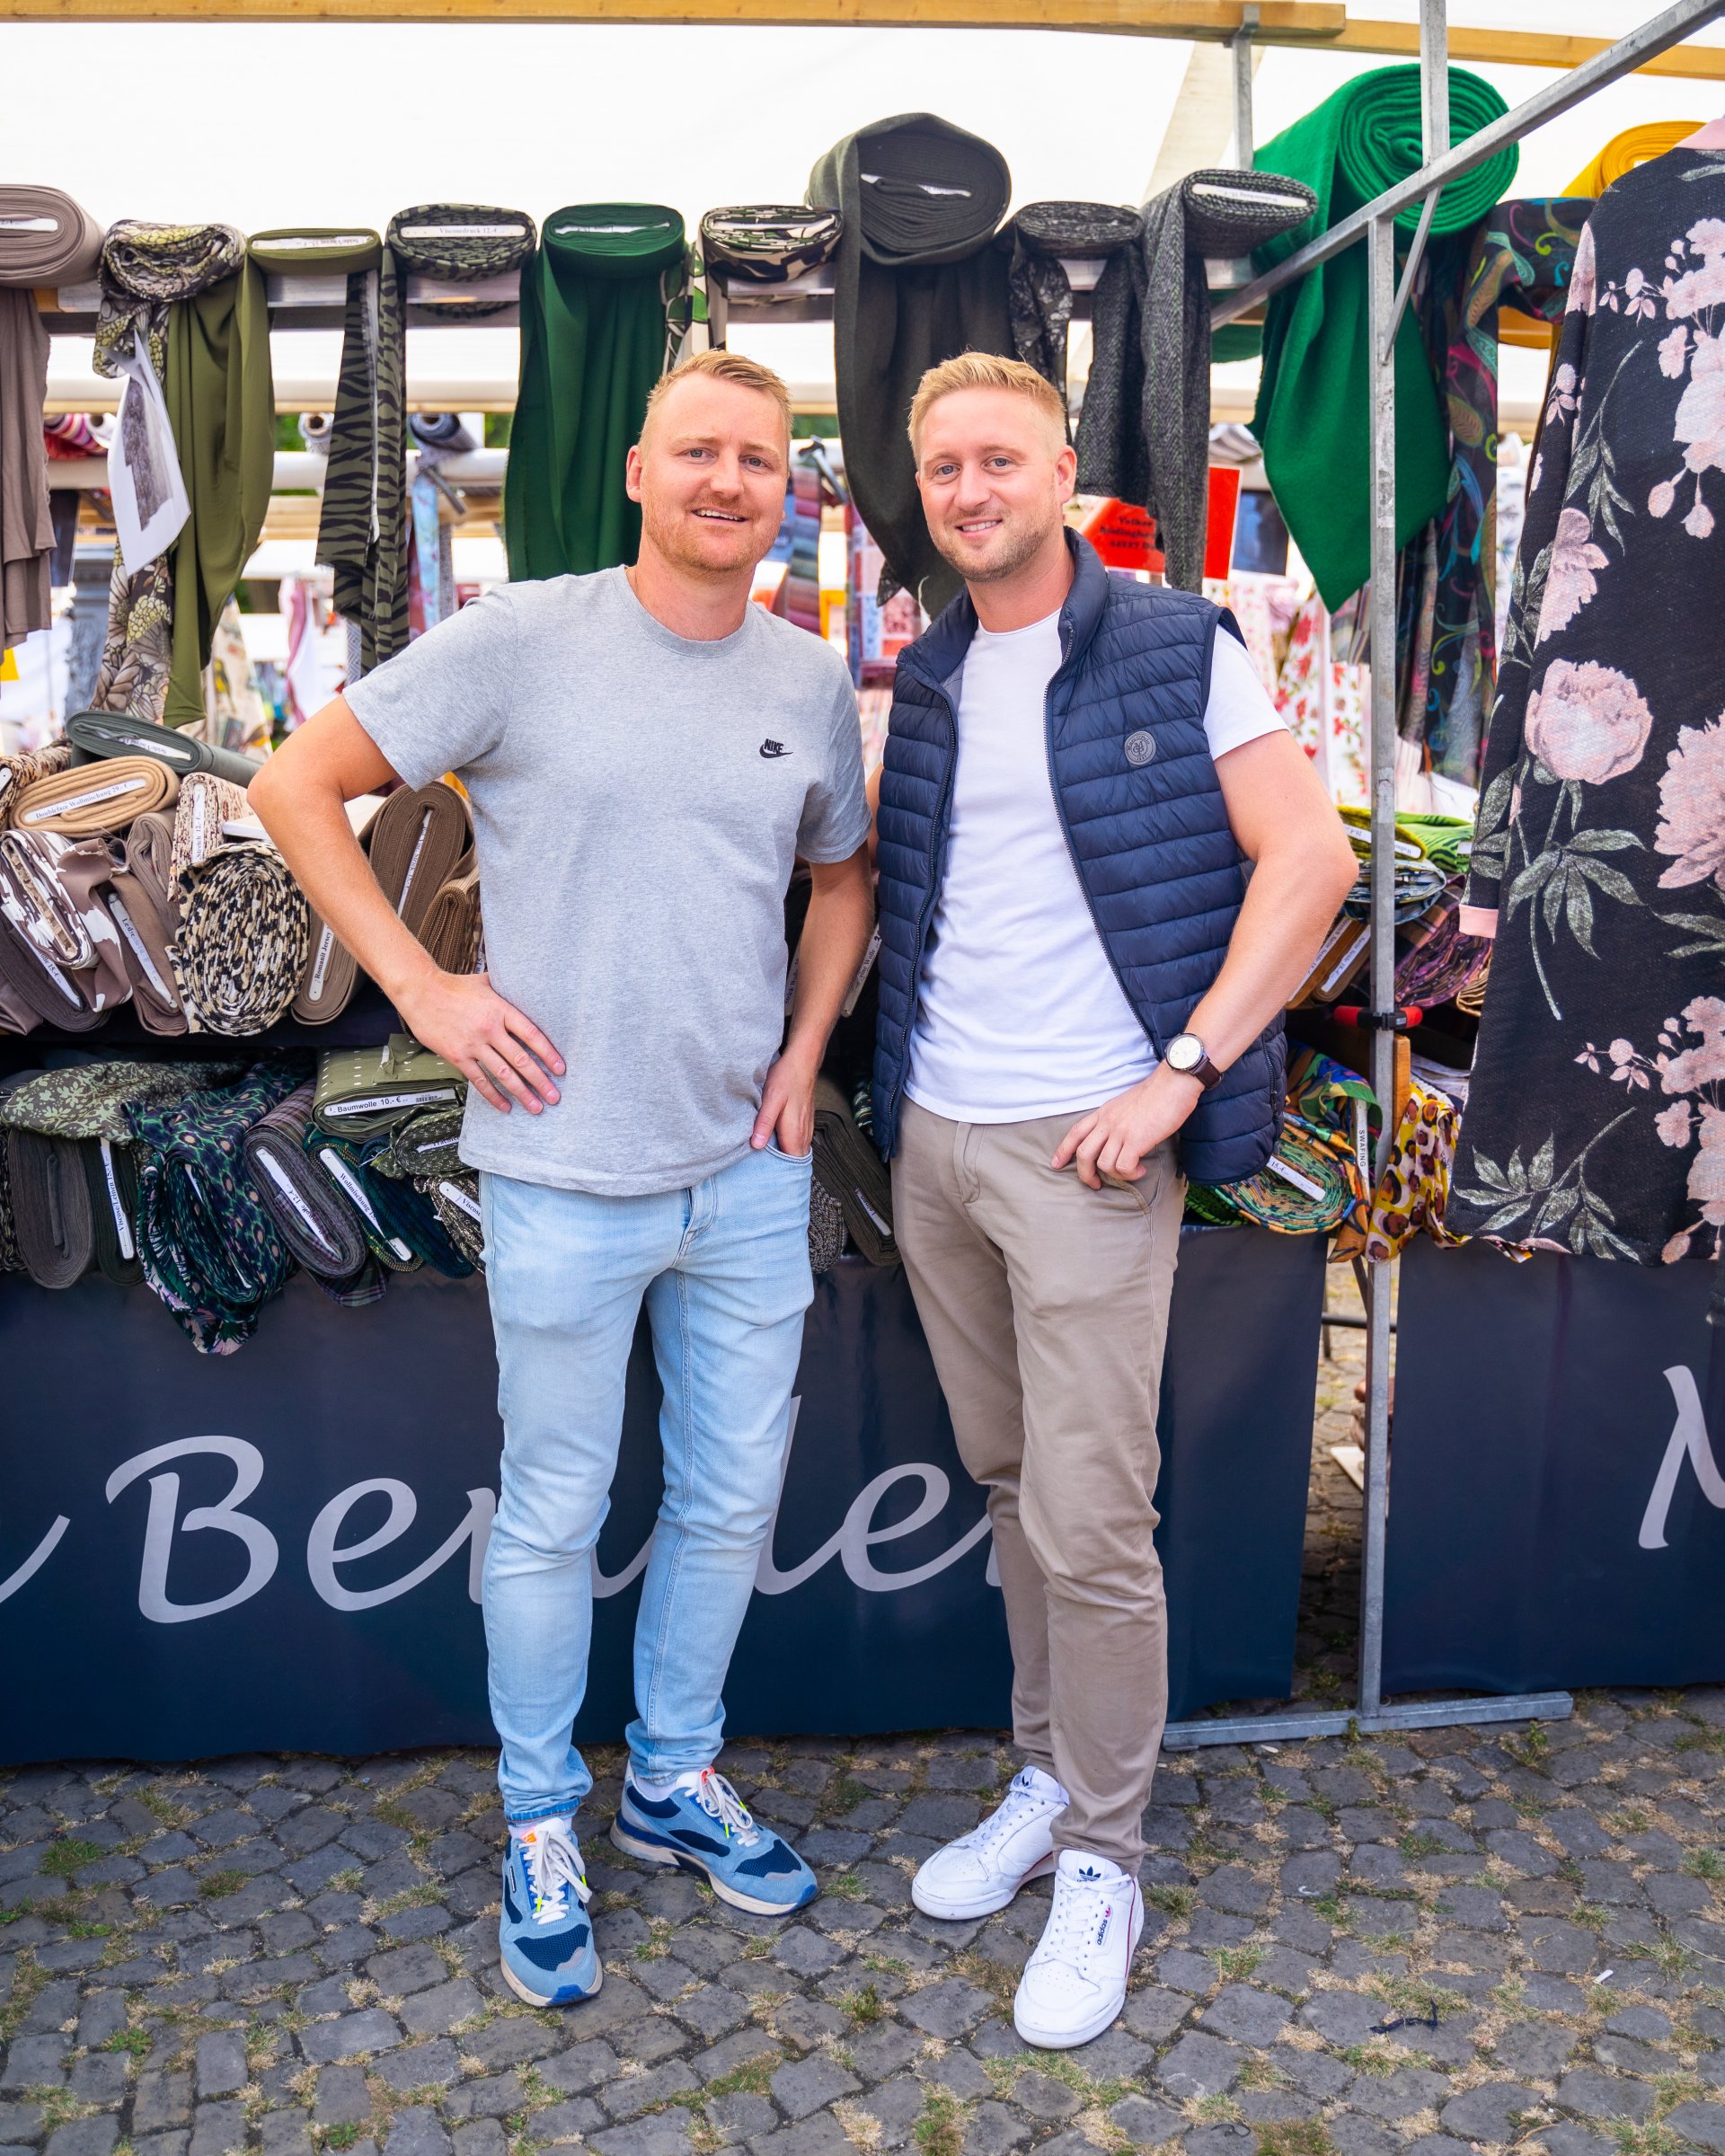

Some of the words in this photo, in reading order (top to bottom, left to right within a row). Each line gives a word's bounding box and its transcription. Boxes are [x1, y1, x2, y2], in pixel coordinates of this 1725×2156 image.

[764, 738, 784, 755] NIKE
[36, 804, 68, 818] Doubleface
[69, 789, 111, 808] Wollmischung
[314, 952, 326, 979] Romanit
[337, 1100, 377, 1113] Baumwolle
[339, 1172, 372, 1212] Wollmischung
[1097, 1919, 1108, 1946] adidas
